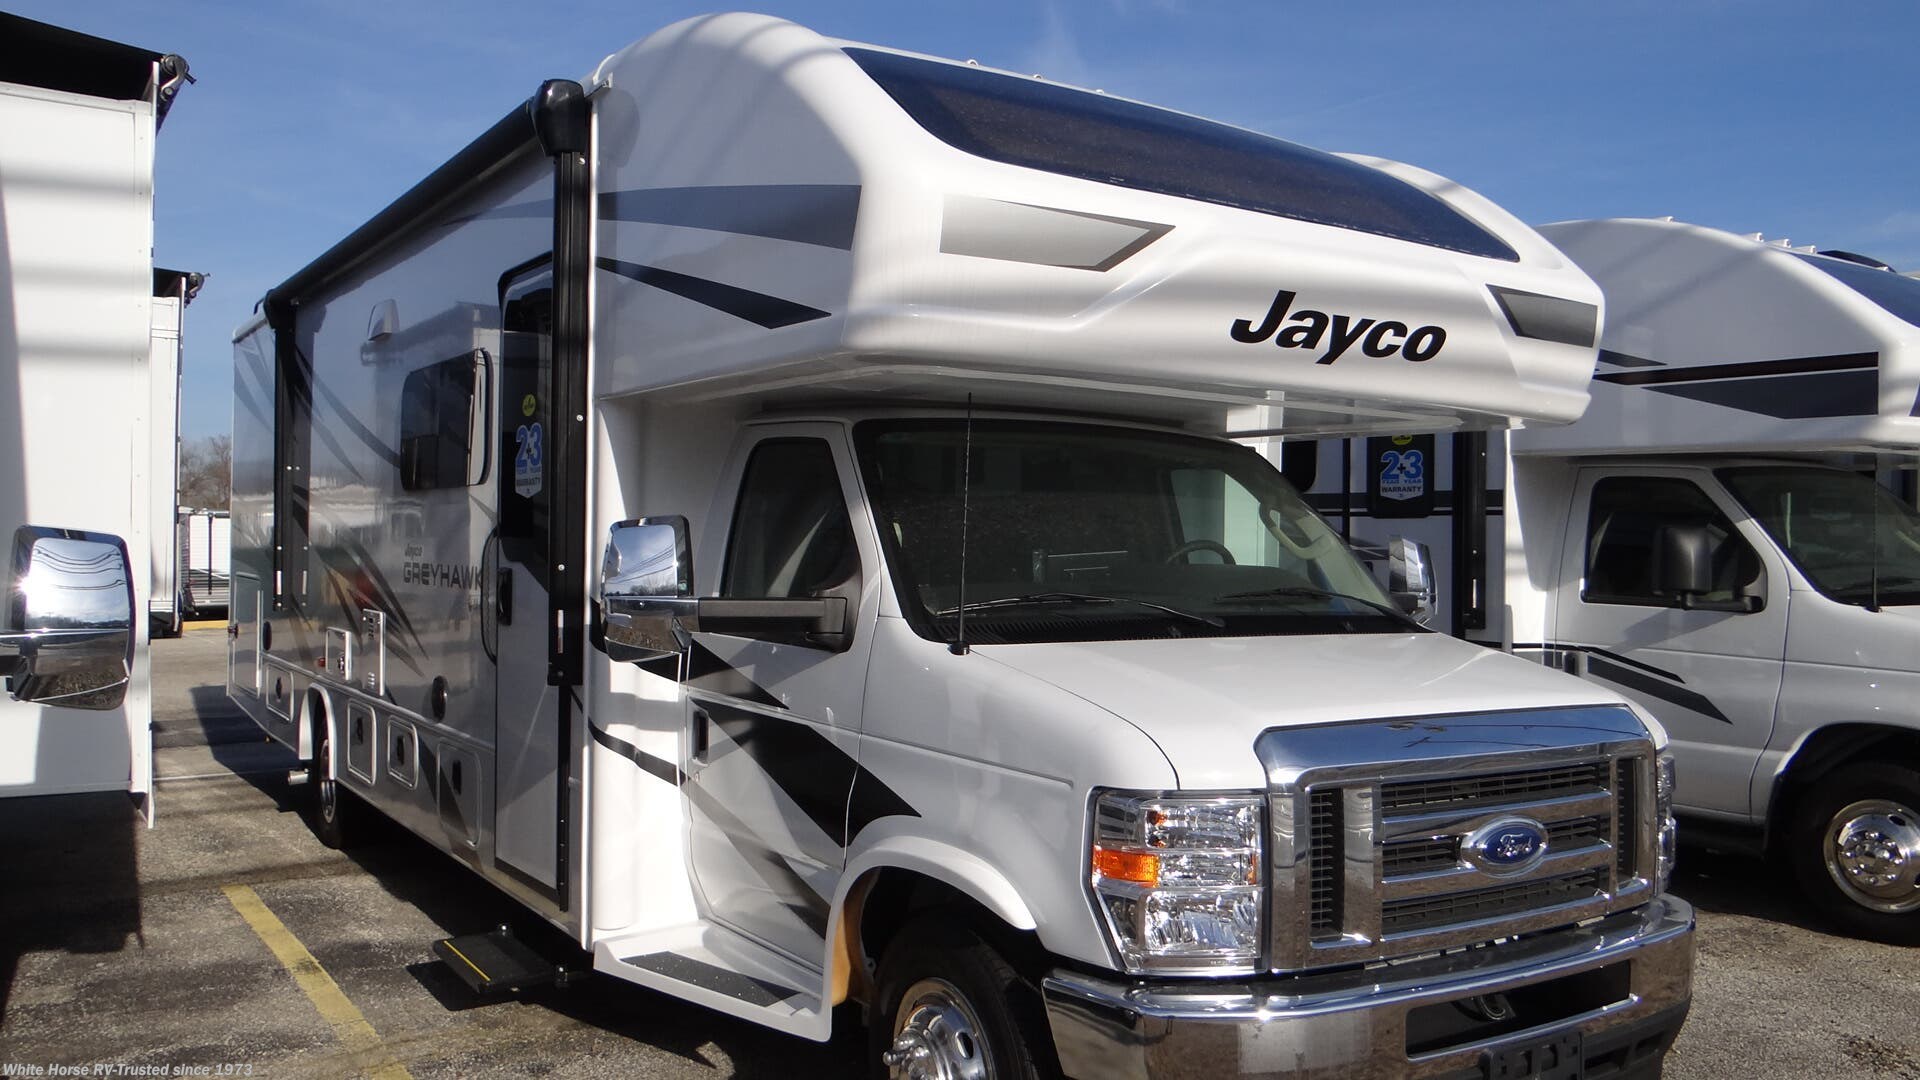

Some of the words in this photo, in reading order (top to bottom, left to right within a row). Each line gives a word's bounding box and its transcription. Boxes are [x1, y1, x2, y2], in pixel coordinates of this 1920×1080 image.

[1230, 290, 1447, 365] Jayco
[403, 562, 482, 591] GREYHAWK
[1497, 833, 1533, 856] Ford
